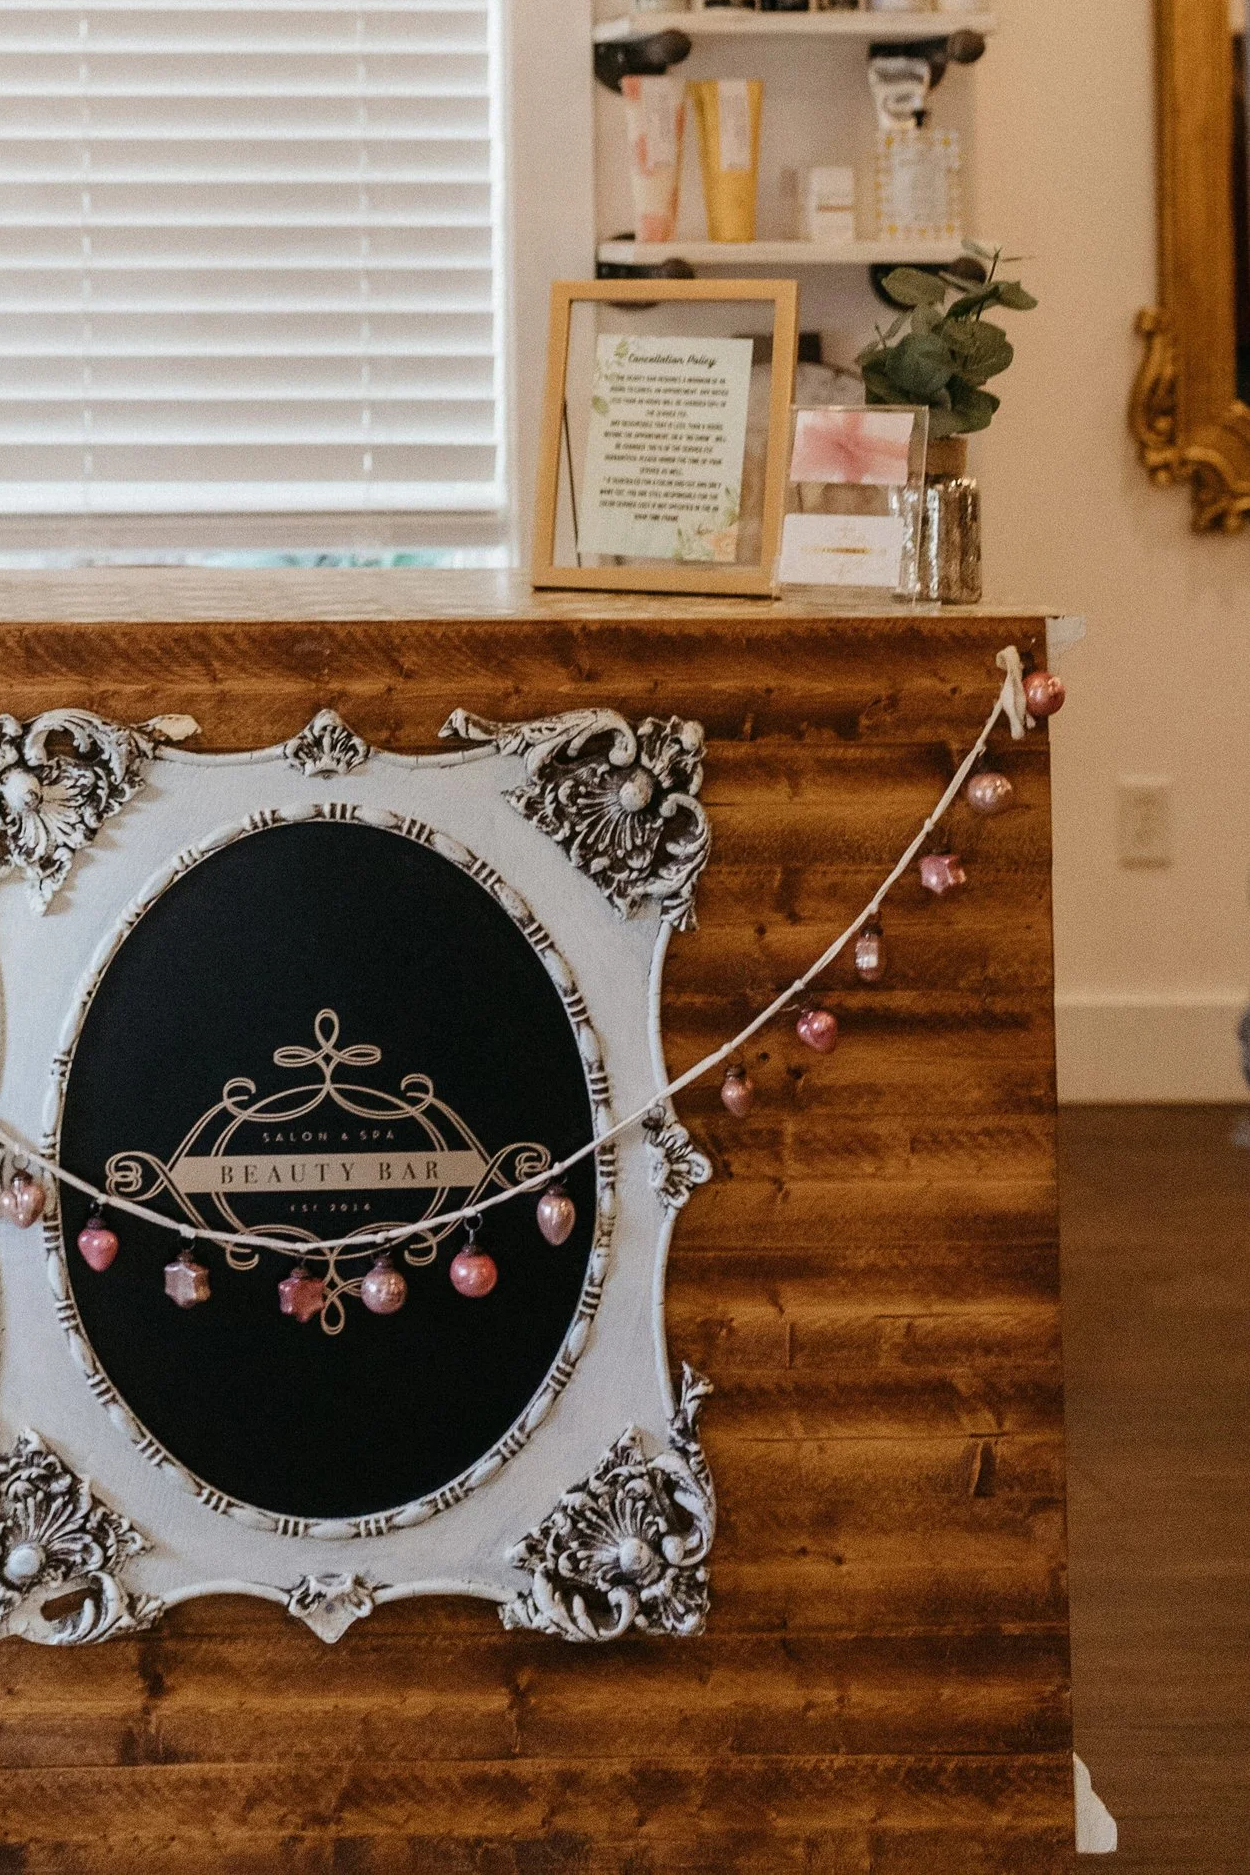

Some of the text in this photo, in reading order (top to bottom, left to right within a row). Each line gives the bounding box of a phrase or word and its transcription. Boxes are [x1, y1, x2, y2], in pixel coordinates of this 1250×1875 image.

[627, 353, 717, 369] Cancellation Policy
[262, 1129, 395, 1143] SALON & SPA
[220, 1160, 440, 1185] BEAUTY BAR
